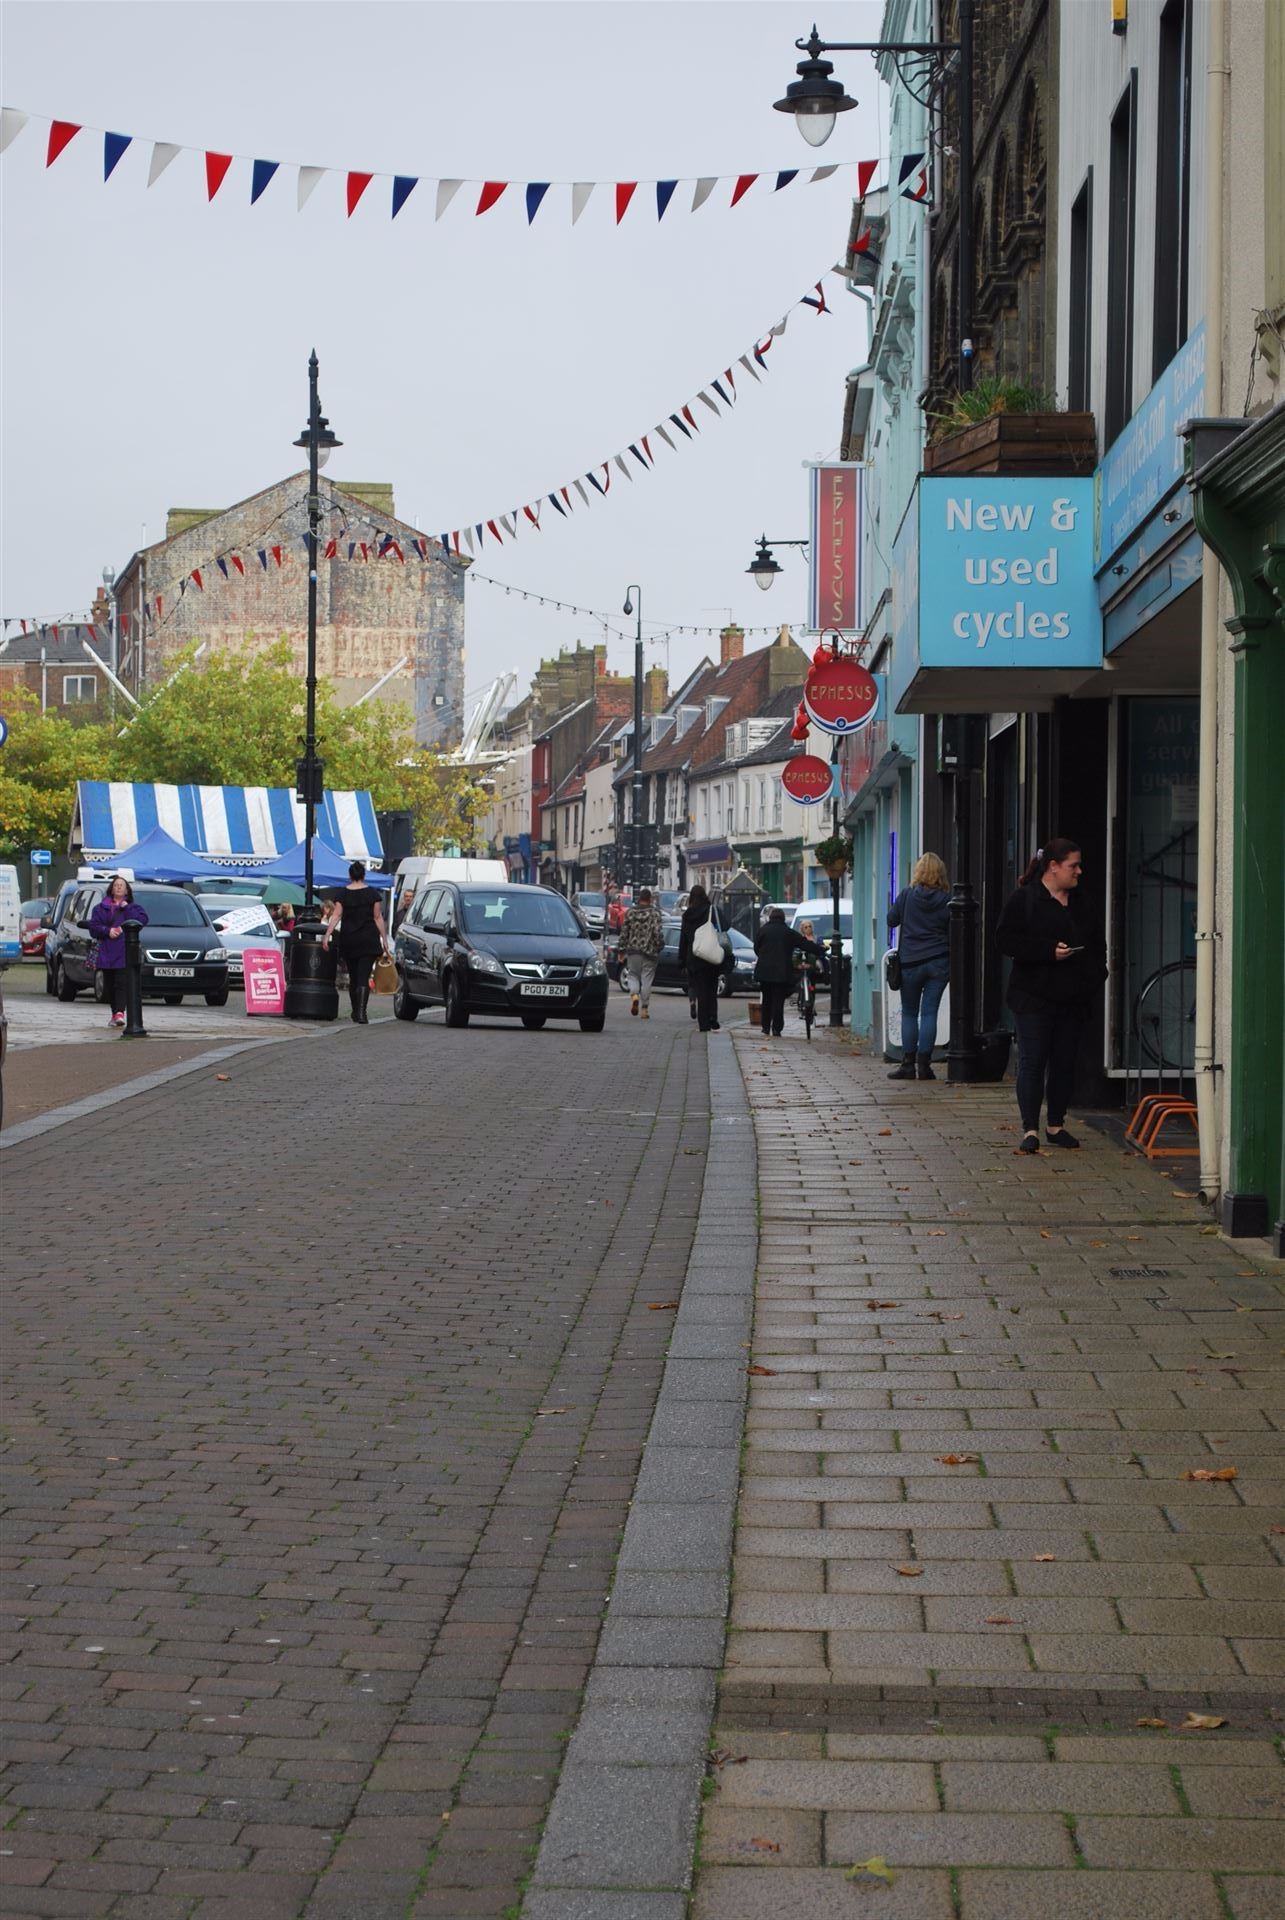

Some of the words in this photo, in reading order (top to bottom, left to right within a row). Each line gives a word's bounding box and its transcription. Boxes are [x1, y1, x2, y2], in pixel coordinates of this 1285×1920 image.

[946, 498, 1035, 532] New
[1050, 498, 1079, 532] &
[832, 475, 844, 622] EPHESUS
[965, 547, 1059, 586] used
[953, 601, 1071, 648] cycles
[810, 685, 873, 700] EPHESUS
[785, 772, 829, 783] EPHESUS
[156, 968, 176, 976] KN55
[178, 968, 192, 976] TZK
[524, 985, 547, 994] PG07
[549, 986, 566, 995] BZH
